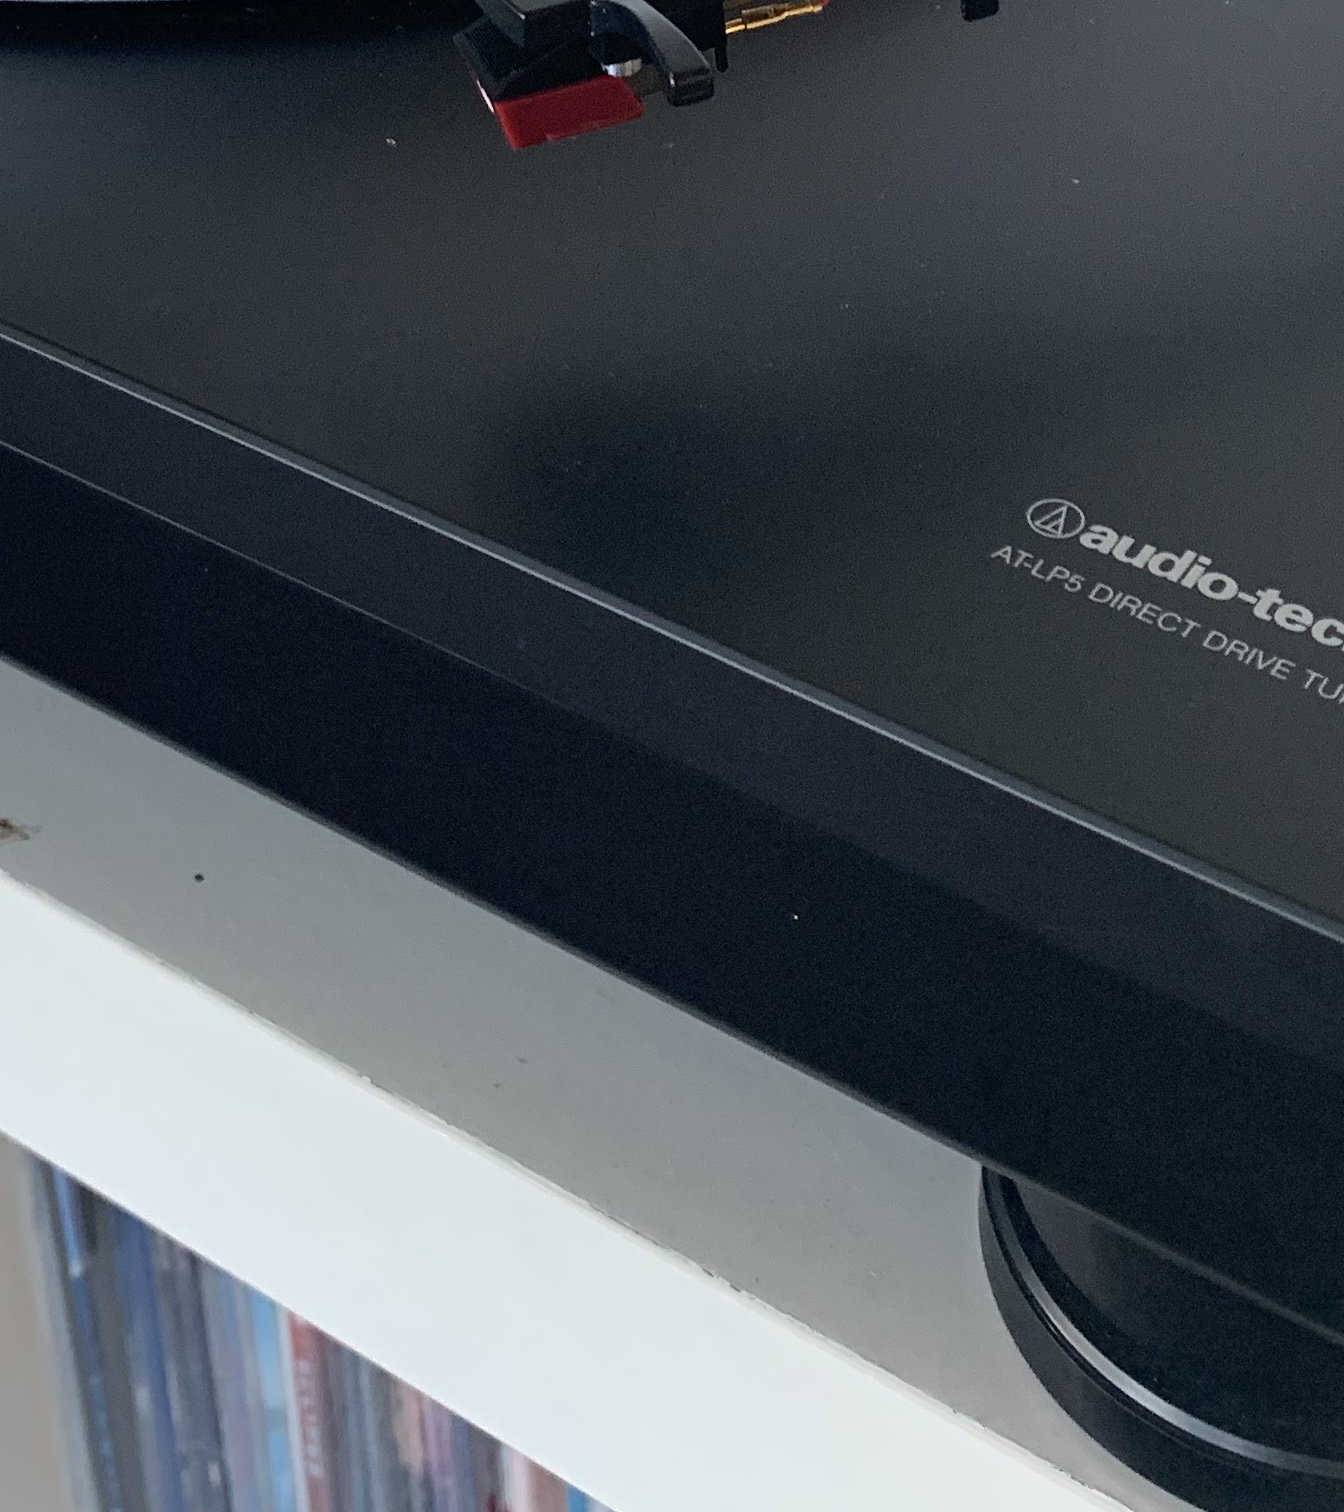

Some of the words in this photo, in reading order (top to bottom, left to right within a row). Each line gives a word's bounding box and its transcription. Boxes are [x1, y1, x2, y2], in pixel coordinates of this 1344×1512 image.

[991, 544, 1086, 593] AT-LP5
[1088, 582, 1202, 638] DIRECT
[1202, 630, 1296, 680] DRIVE
